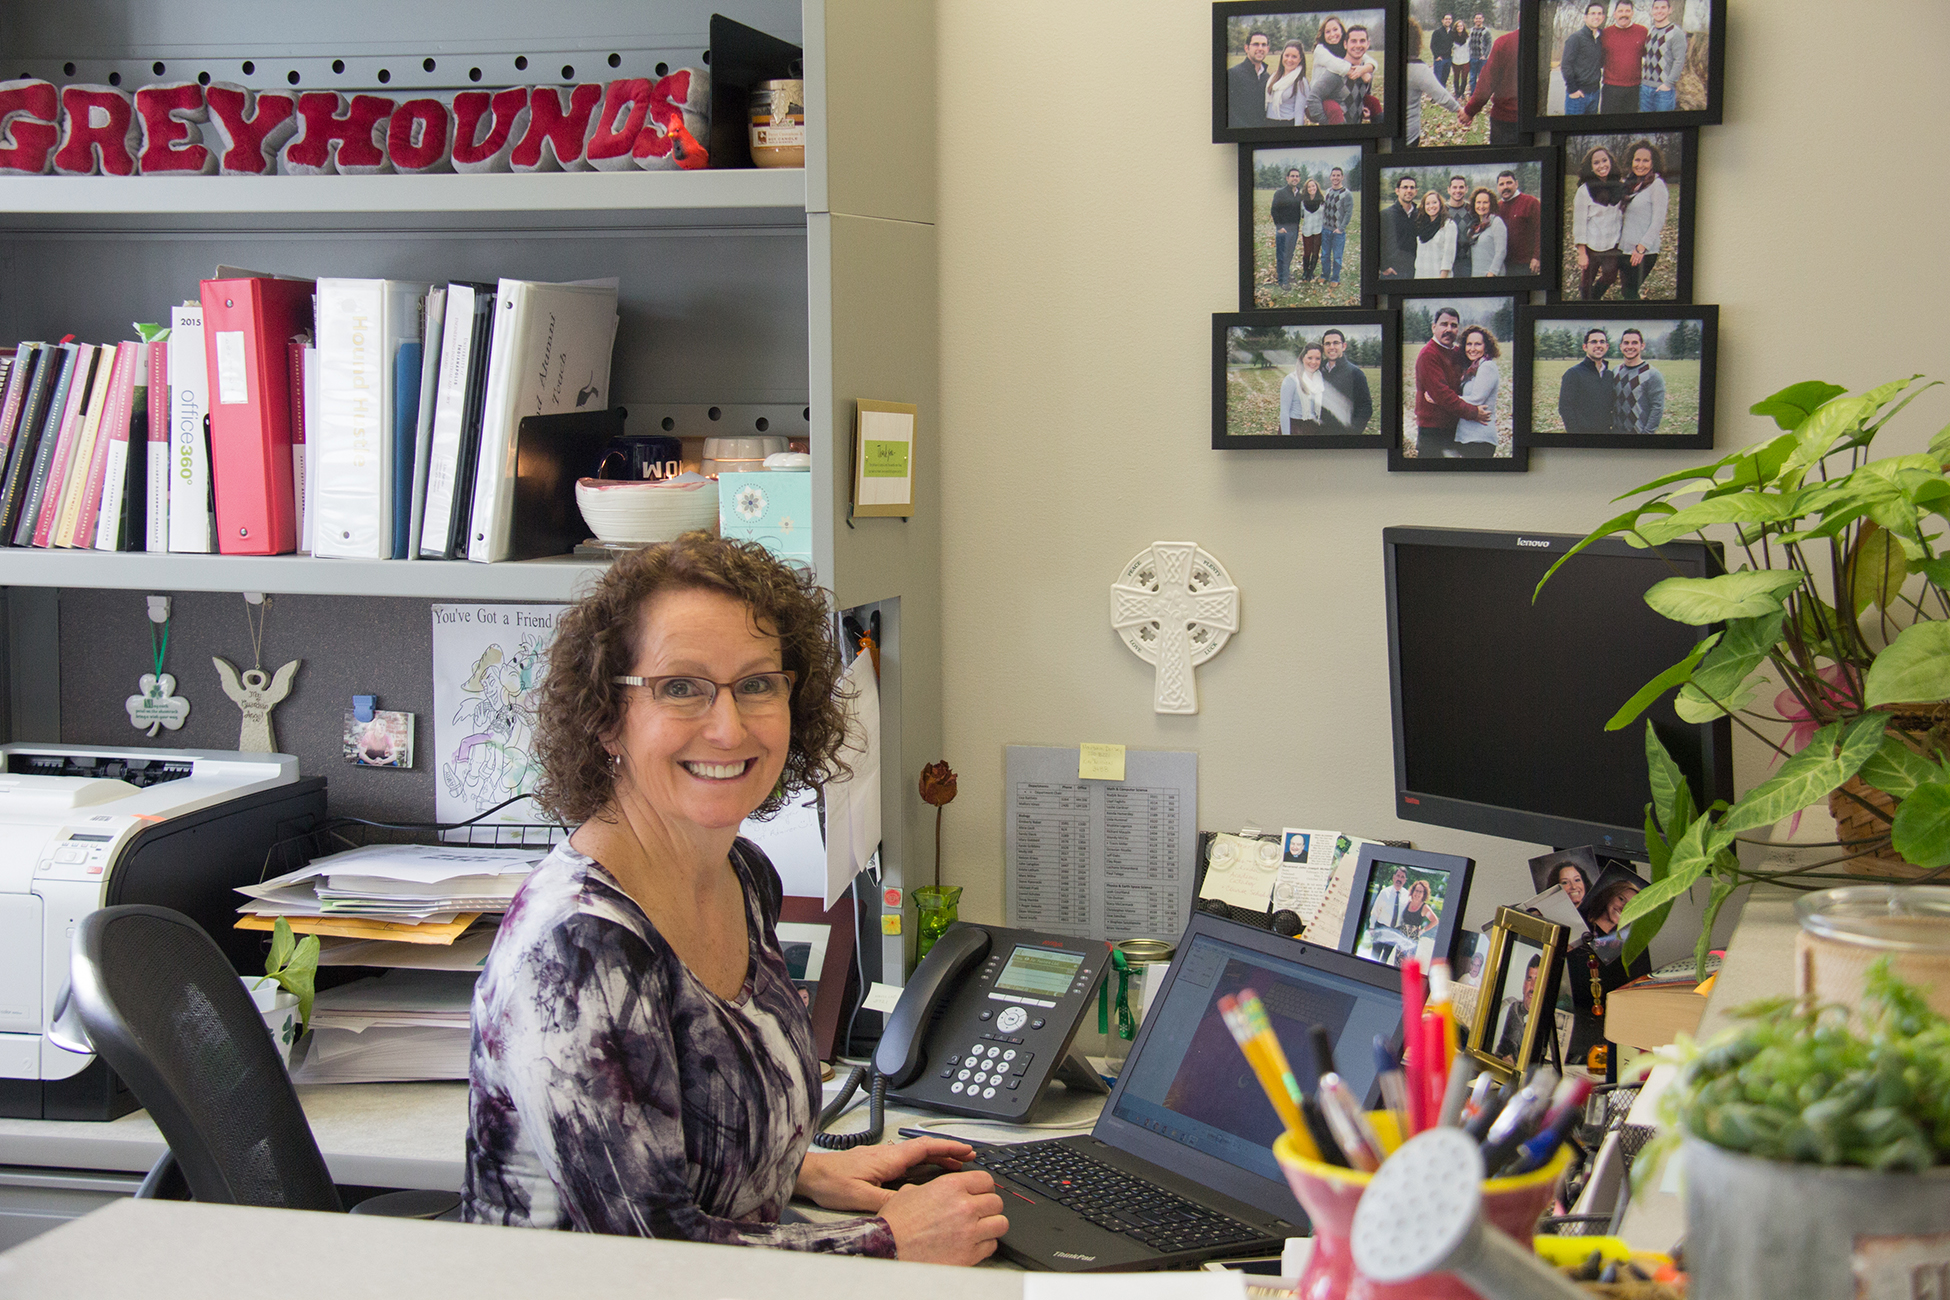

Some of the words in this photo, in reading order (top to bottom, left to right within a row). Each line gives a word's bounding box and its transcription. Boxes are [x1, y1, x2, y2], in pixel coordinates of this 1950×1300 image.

[180, 318, 201, 326] 2015
[352, 316, 369, 389] Hound
[539, 311, 555, 390] Alumni
[552, 353, 566, 406] Touch
[23, 401, 35, 437] INDIANAPOLIS
[47, 401, 58, 437] INDIANAPOLIS
[63, 400, 76, 441] INDIANAPOLIS
[85, 400, 97, 442] INDIANAPOLIS
[100, 399, 112, 441] INDIANAPOLIS
[117, 395, 125, 436] INDIANAPOLIS
[1517, 537, 1550, 547] lenovo
[1128, 561, 1141, 577] PEACE
[1203, 560, 1221, 577] PLENTY
[435, 608, 471, 624] You've
[477, 608, 497, 624] Got
[503, 614, 509, 624] a
[516, 611, 552, 628] Friend
[1129, 639, 1142, 653] LOVE
[1204, 642, 1218, 655] LUCK
[1053, 1251, 1096, 1261] ThinkPad
